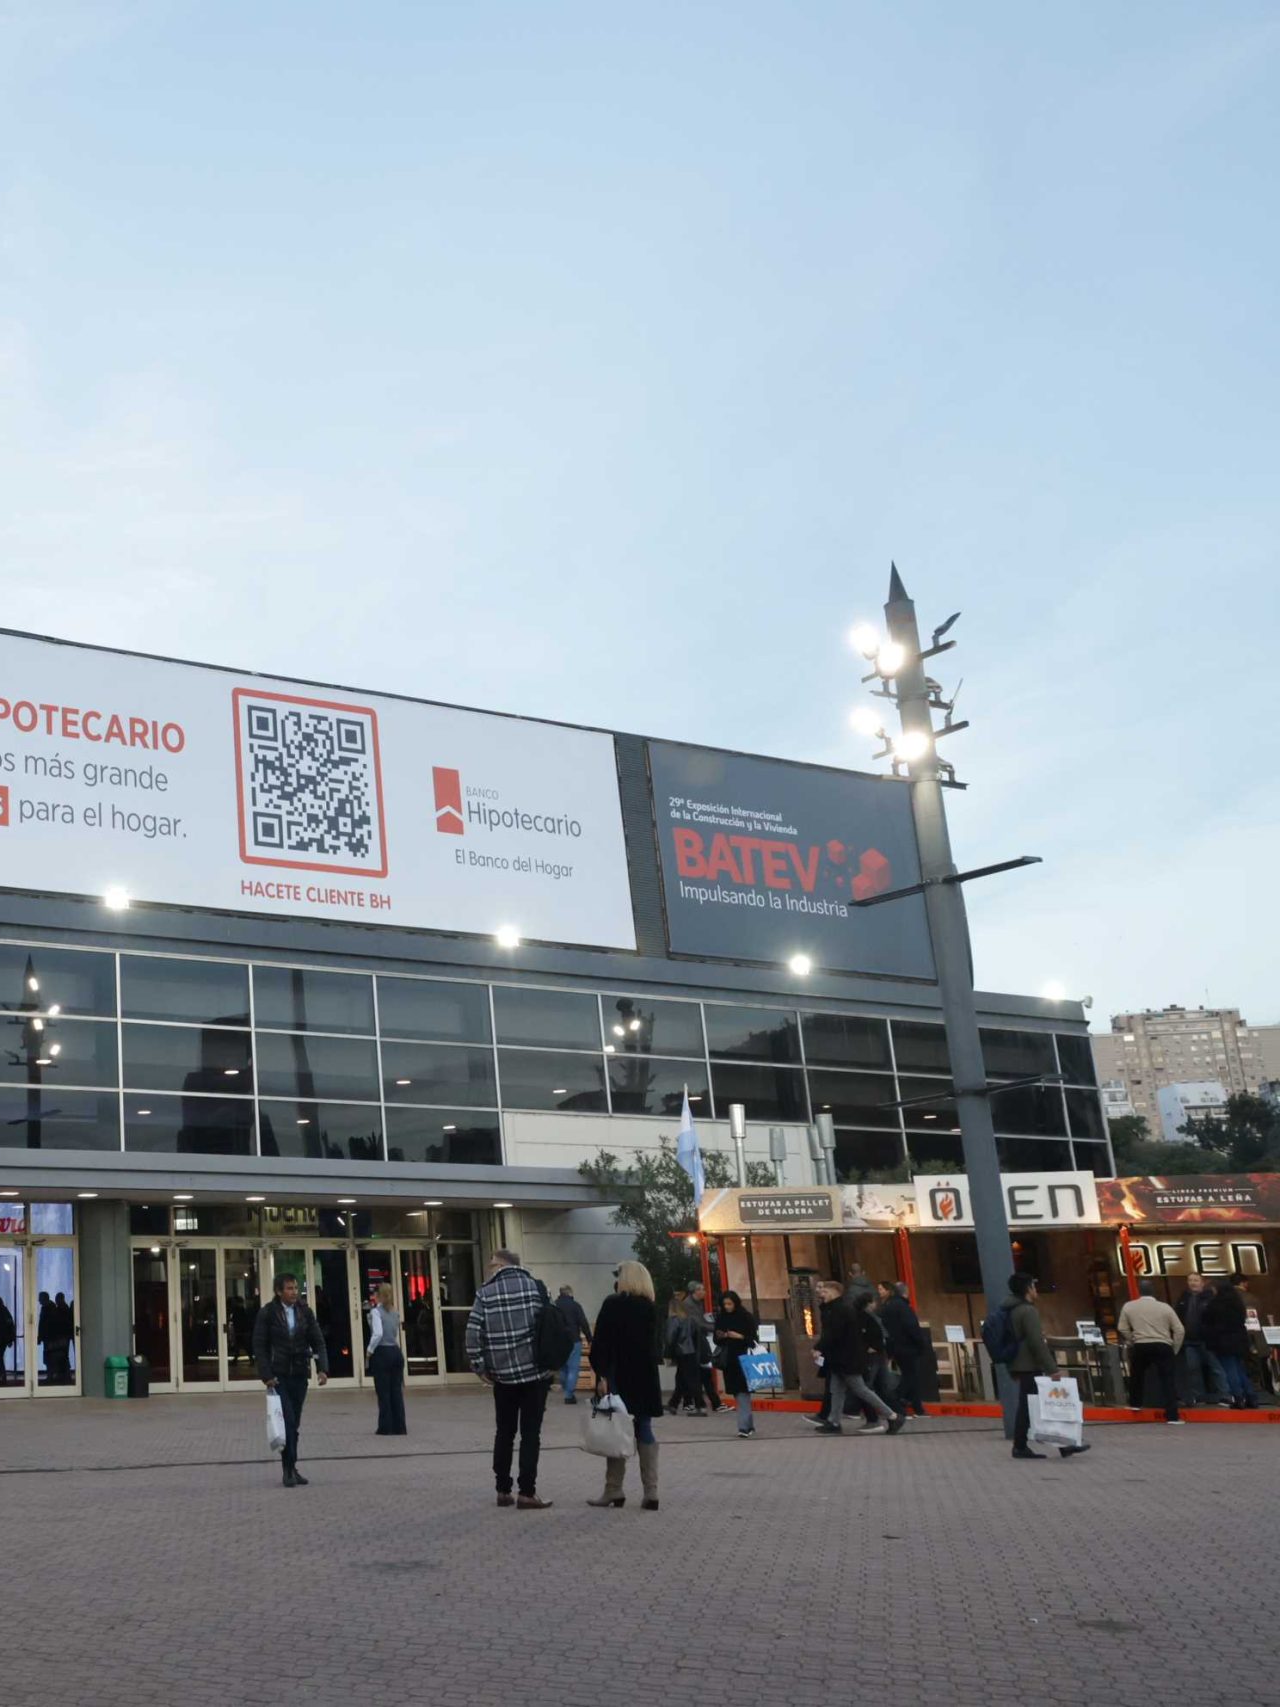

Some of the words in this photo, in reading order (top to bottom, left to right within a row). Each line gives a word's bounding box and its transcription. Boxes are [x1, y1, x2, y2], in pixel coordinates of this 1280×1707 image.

[24, 753, 75, 780] más
[83, 765, 168, 792] grande
[466, 786, 499, 800] BANCO
[20, 798, 74, 824] para
[83, 802, 102, 828] el
[112, 804, 187, 839] hogar.
[467, 801, 582, 837] Hipotecario
[670, 809, 681, 819] de
[683, 810, 691, 820] la
[693, 812, 745, 829] Construcción
[747, 821, 753, 832] y
[754, 819, 762, 831] la
[763, 821, 798, 836] Vivienda
[687, 799, 729, 815] Exposición
[731, 805, 782, 822] Internacional
[455, 849, 466, 864] El
[469, 853, 509, 870] Banco
[512, 856, 532, 872] del
[535, 861, 573, 879] Hogar
[672, 827, 820, 894] BATEV
[240, 880, 301, 901] HACETE
[306, 886, 365, 908] CLIENTE
[370, 894, 391, 910] BH
[680, 881, 765, 908] Impulsando
[769, 891, 782, 910] la
[786, 896, 848, 918] Industria
[740, 1200, 782, 1208] ESTUFAS
[785, 1199, 792, 1207] A
[794, 1198, 830, 1207] PELLET
[758, 1208, 771, 1216] DE
[774, 1207, 813, 1216] MADERA
[1157, 1195, 1203, 1204] ESTUFAS
[1208, 1195, 1215, 1203] A
[1220, 1193, 1252, 1202] LEÑA
